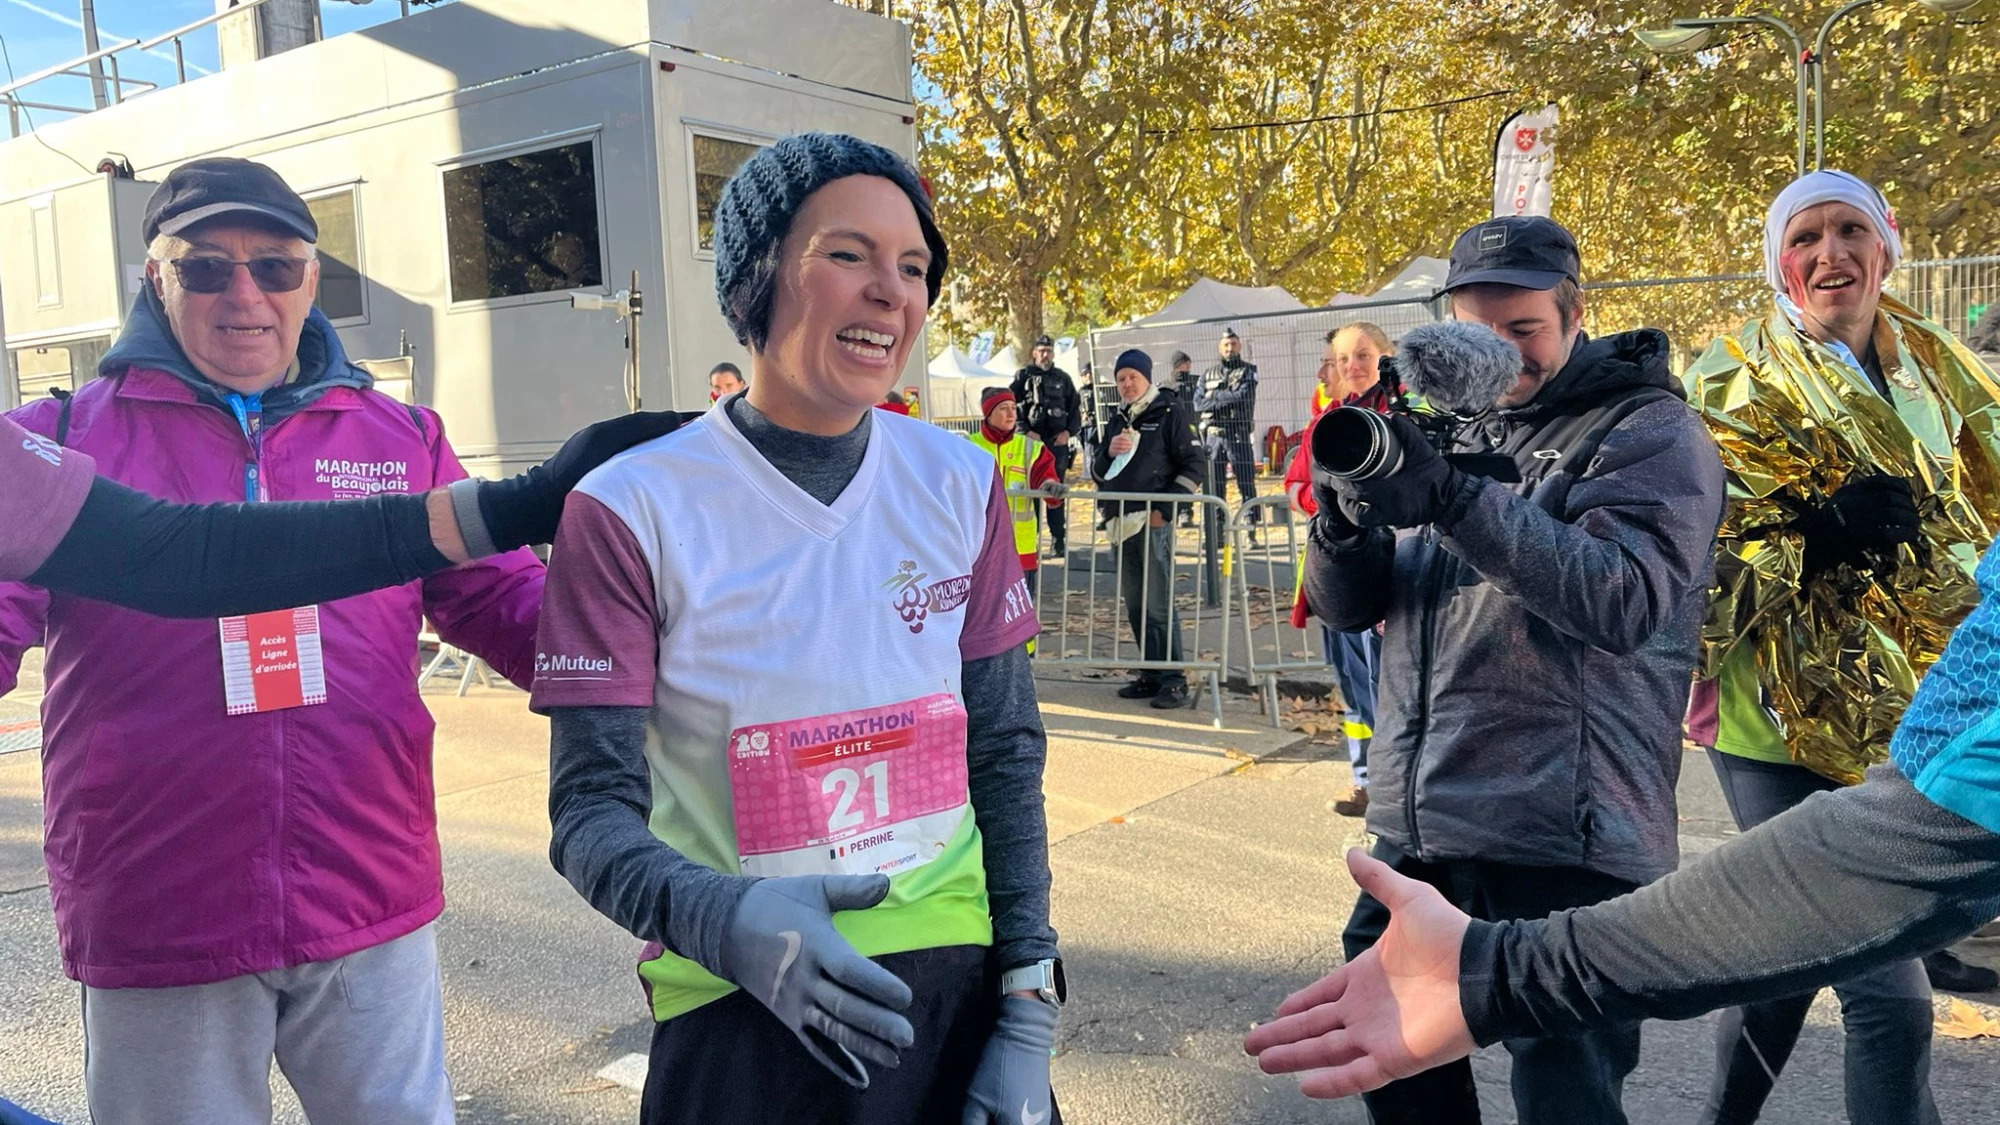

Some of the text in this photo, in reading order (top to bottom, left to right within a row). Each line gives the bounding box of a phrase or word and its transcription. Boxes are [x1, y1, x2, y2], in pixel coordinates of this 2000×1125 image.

[315, 459, 406, 477] MARATHON
[316, 474, 409, 495] du Beaujolais
[260, 635, 287, 646] Accès
[262, 650, 288, 661] Ligne
[551, 655, 613, 671] Mutuel
[255, 661, 298, 674] d'arrivée
[790, 711, 915, 748] MARATHON
[834, 741, 872, 757] ÉLITE
[821, 761, 890, 834] 21
[850, 831, 894, 853] PERRINE
[880, 853, 917, 871] INTERSPORT
